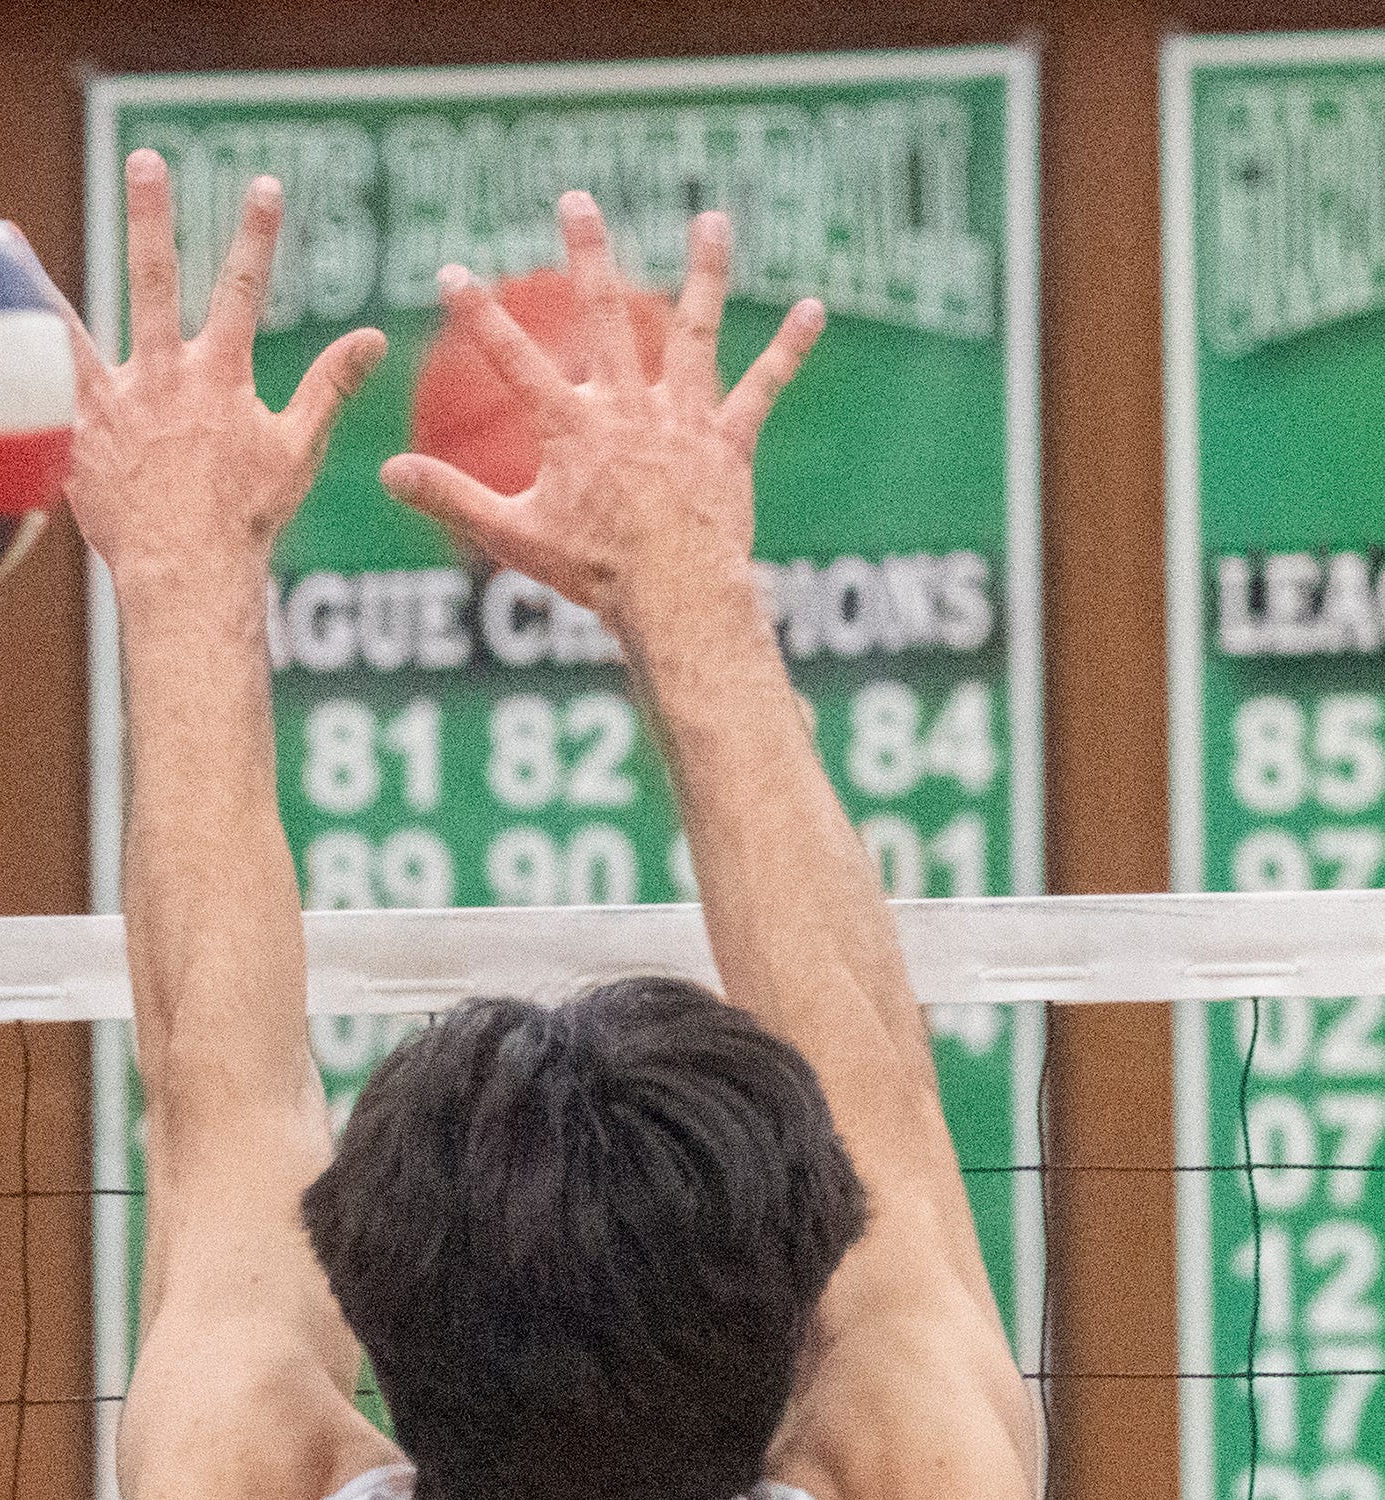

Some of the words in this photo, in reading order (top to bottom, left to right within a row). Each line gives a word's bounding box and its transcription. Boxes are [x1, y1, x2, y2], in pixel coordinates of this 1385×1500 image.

[267, 564, 477, 672] GUE
[1217, 549, 1385, 657] LEA
[303, 695, 445, 815] 81
[487, 691, 640, 812] 82
[847, 678, 1000, 799] 84
[1230, 692, 1384, 817] 85
[485, 822, 640, 906] 90
[1235, 1091, 1385, 1211] 07
[1230, 1219, 1382, 1341] 12
[1233, 1346, 1383, 1461] 17
